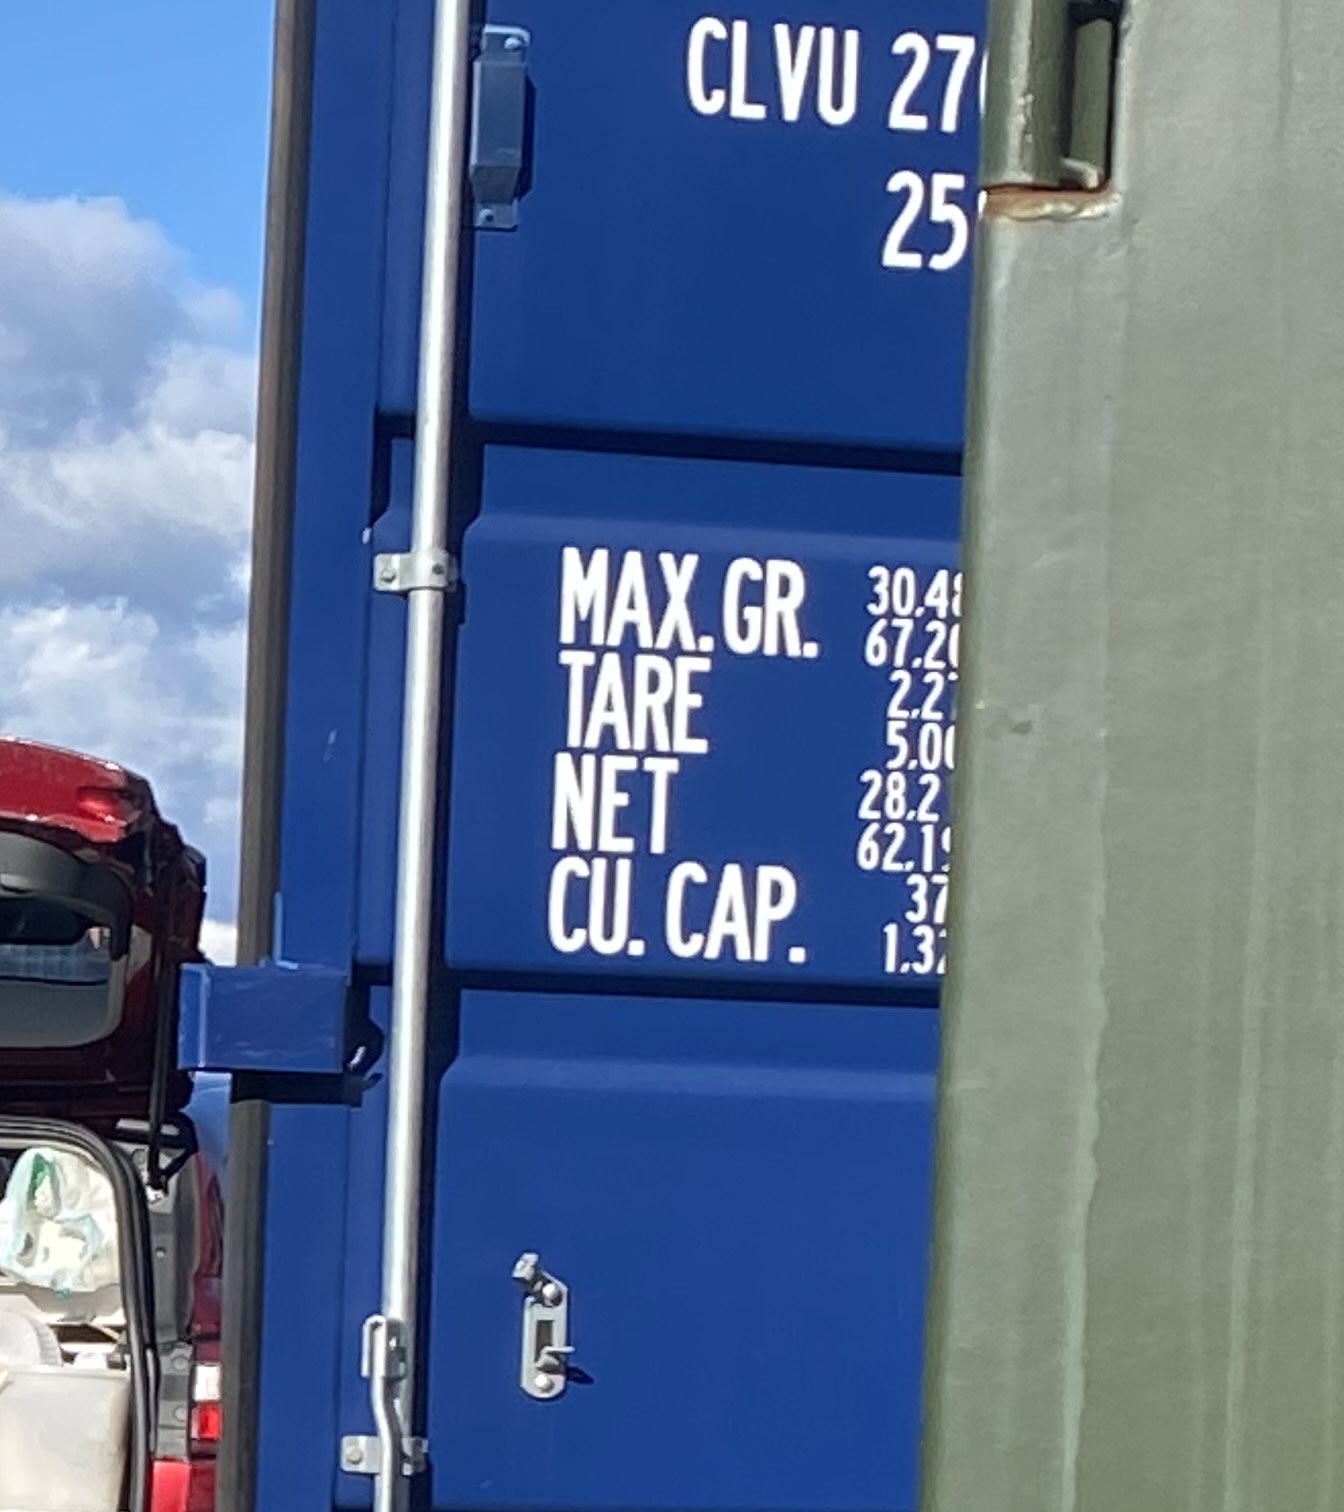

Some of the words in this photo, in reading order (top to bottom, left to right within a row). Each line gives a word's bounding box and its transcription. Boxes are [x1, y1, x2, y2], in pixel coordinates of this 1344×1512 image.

[687, 17, 859, 126] CLVU
[887, 31, 988, 133] 27
[882, 170, 986, 271] 25
[559, 649, 711, 754] TARE
[552, 752, 679, 854] NET
